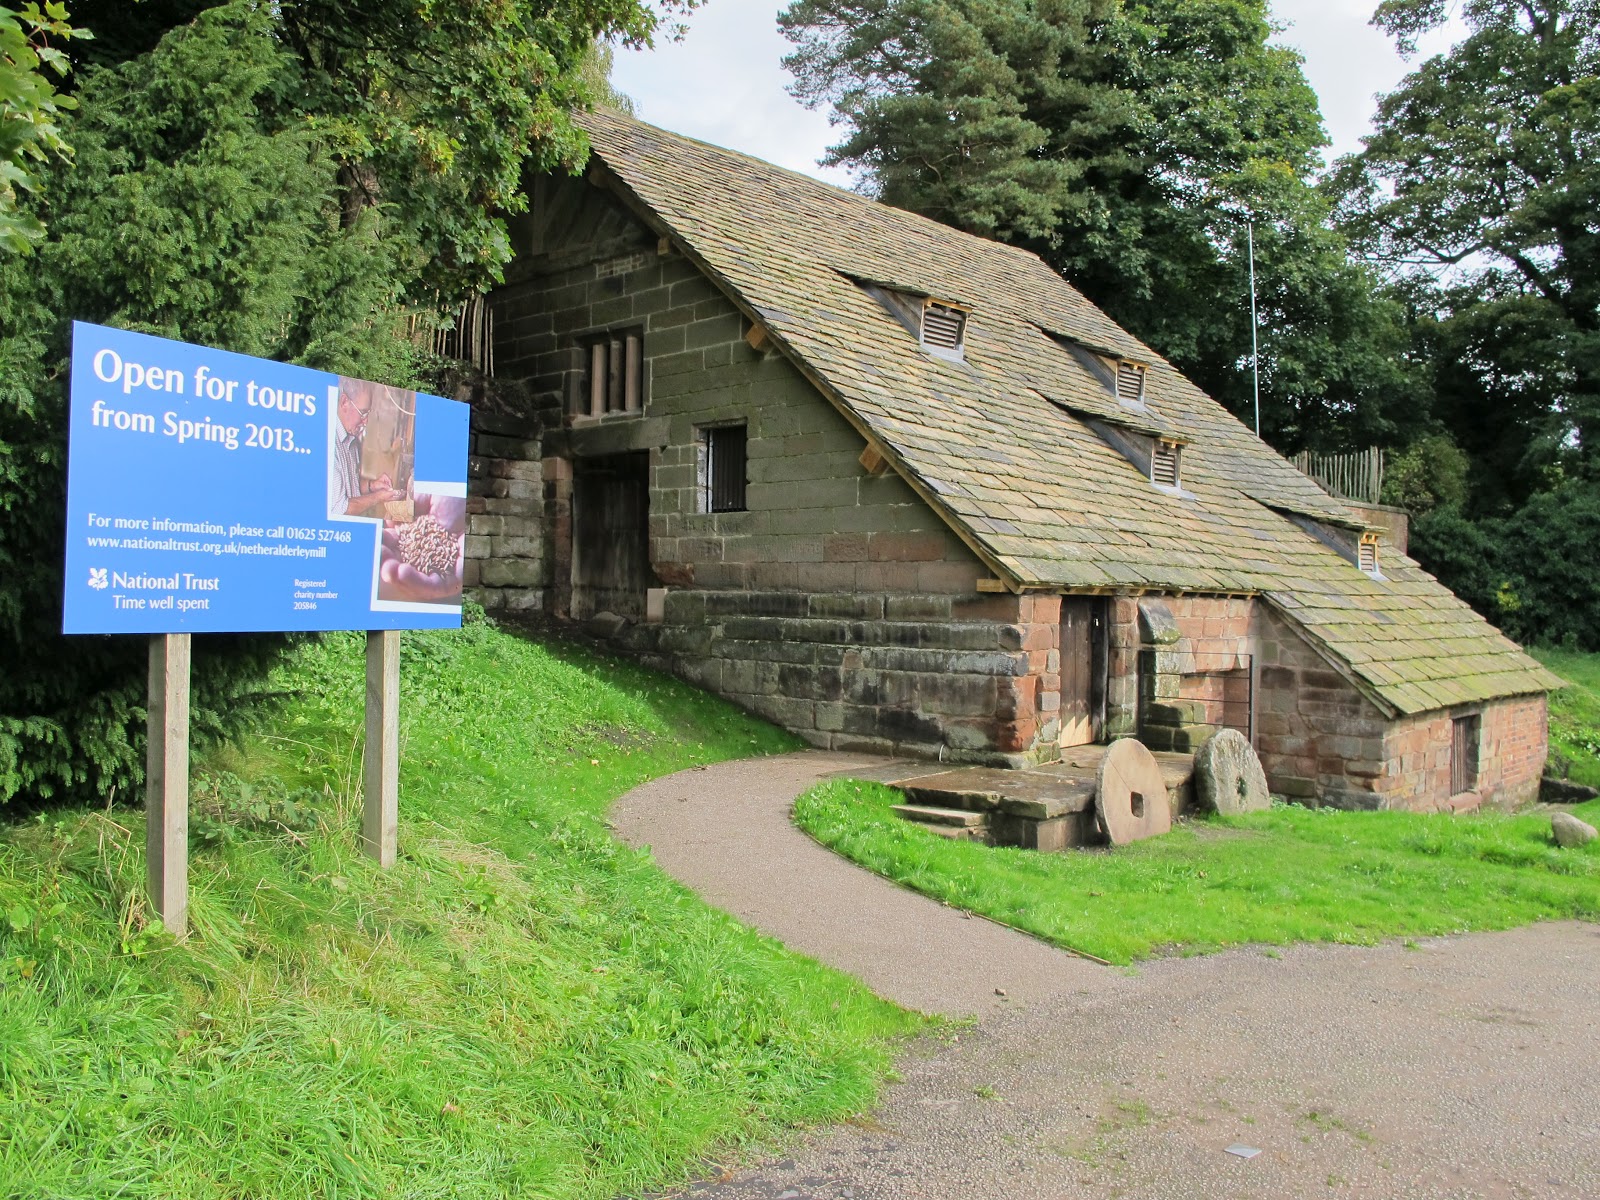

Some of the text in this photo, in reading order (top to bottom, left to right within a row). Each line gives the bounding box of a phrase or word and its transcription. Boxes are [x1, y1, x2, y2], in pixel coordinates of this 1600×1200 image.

[93, 349, 317, 416] Open for tours
[91, 400, 311, 454] from Spring 2013...
[88, 512, 352, 543] For more information, please call 01625 527468
[87, 536, 327, 560] www.nationaltrust.org.uk/netheralderleymill
[112, 571, 220, 590] National Trust
[294, 578, 327, 589] Registered
[112, 594, 210, 613] Time well spent
[294, 590, 338, 600] charity number
[293, 601, 317, 610] 205846
